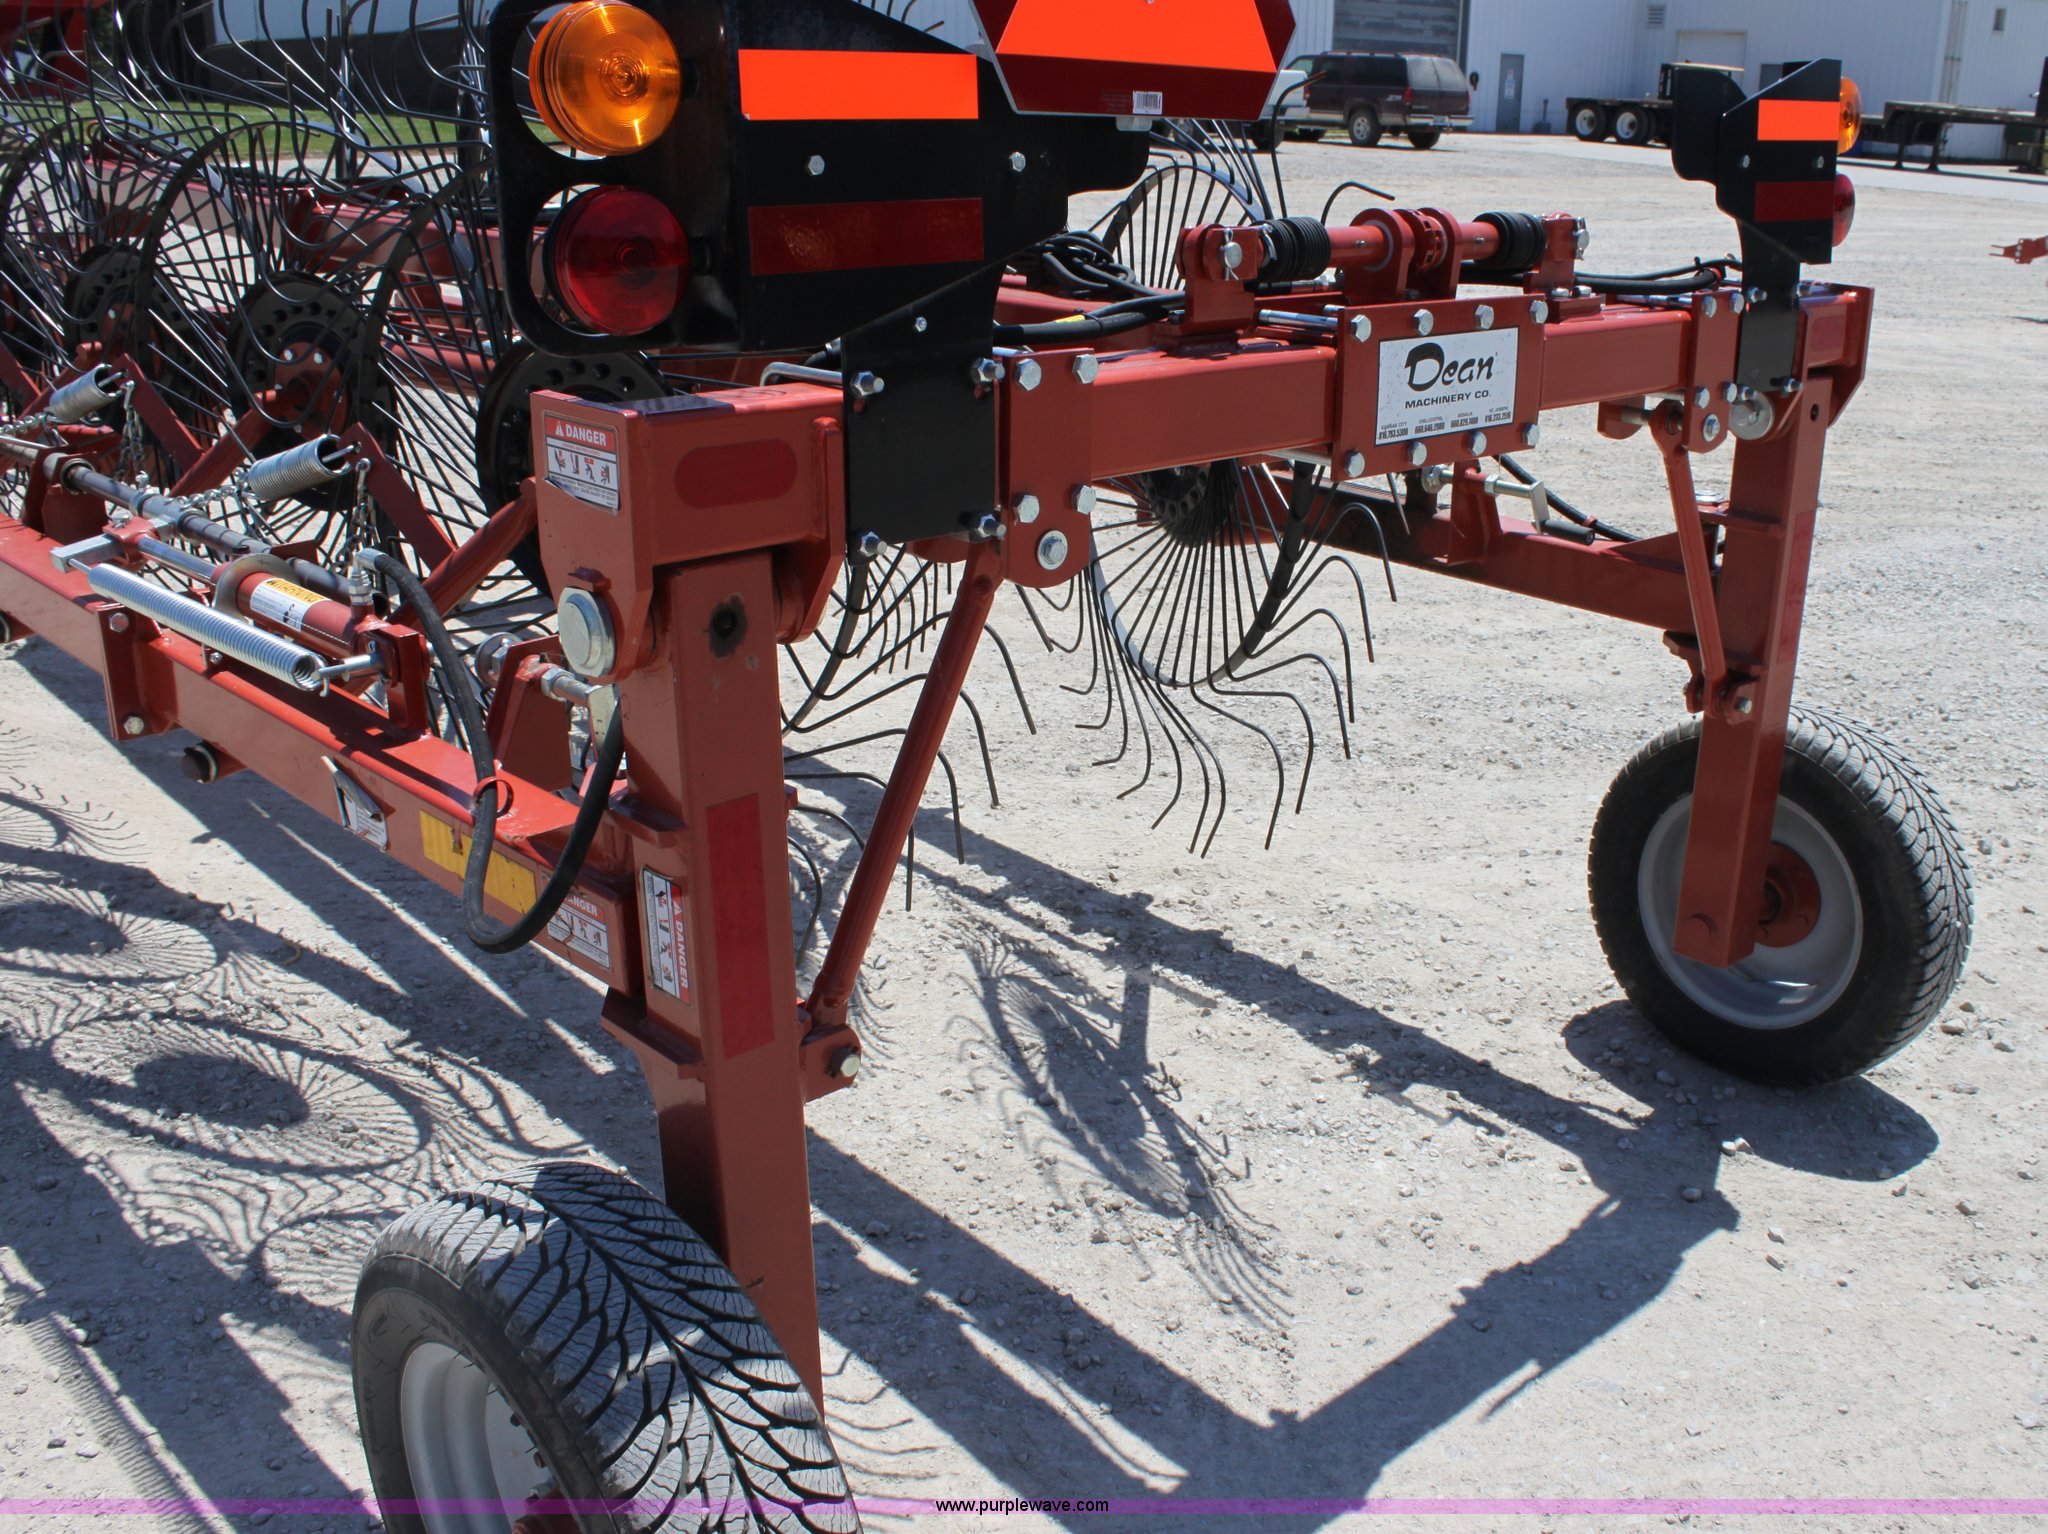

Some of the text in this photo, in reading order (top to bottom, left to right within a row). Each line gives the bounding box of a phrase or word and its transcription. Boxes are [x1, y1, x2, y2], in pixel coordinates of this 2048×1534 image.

[1404, 342, 1494, 392] Dean
[1405, 389, 1492, 409] MACHINERY CO.
[565, 423, 607, 447] DANGER
[567, 895, 598, 916] ANGER
[675, 920, 689, 989] DANGER
